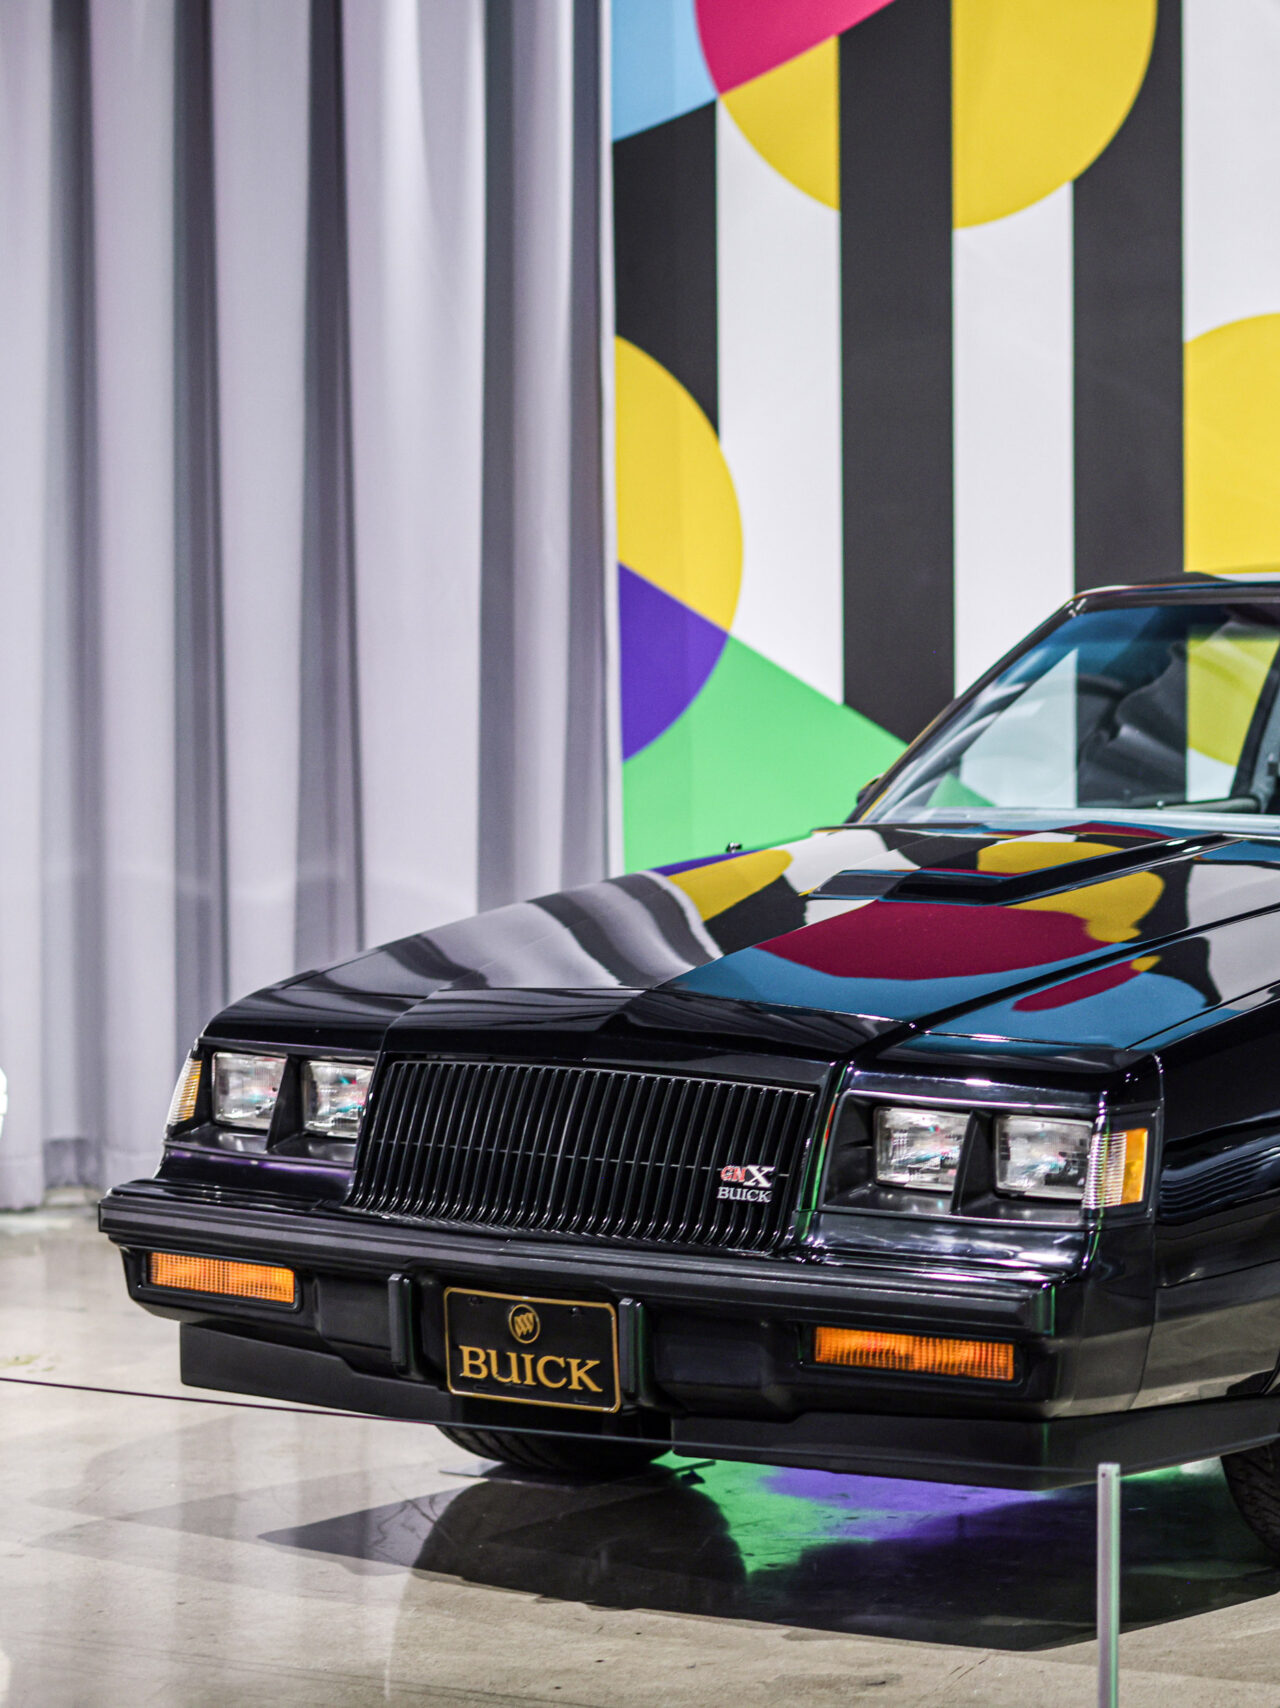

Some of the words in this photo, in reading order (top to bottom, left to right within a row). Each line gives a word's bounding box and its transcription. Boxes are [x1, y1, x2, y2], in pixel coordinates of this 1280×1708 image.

[721, 1165, 775, 1188] GNX
[717, 1186, 773, 1203] BUICK
[458, 1345, 604, 1392] BUICK
